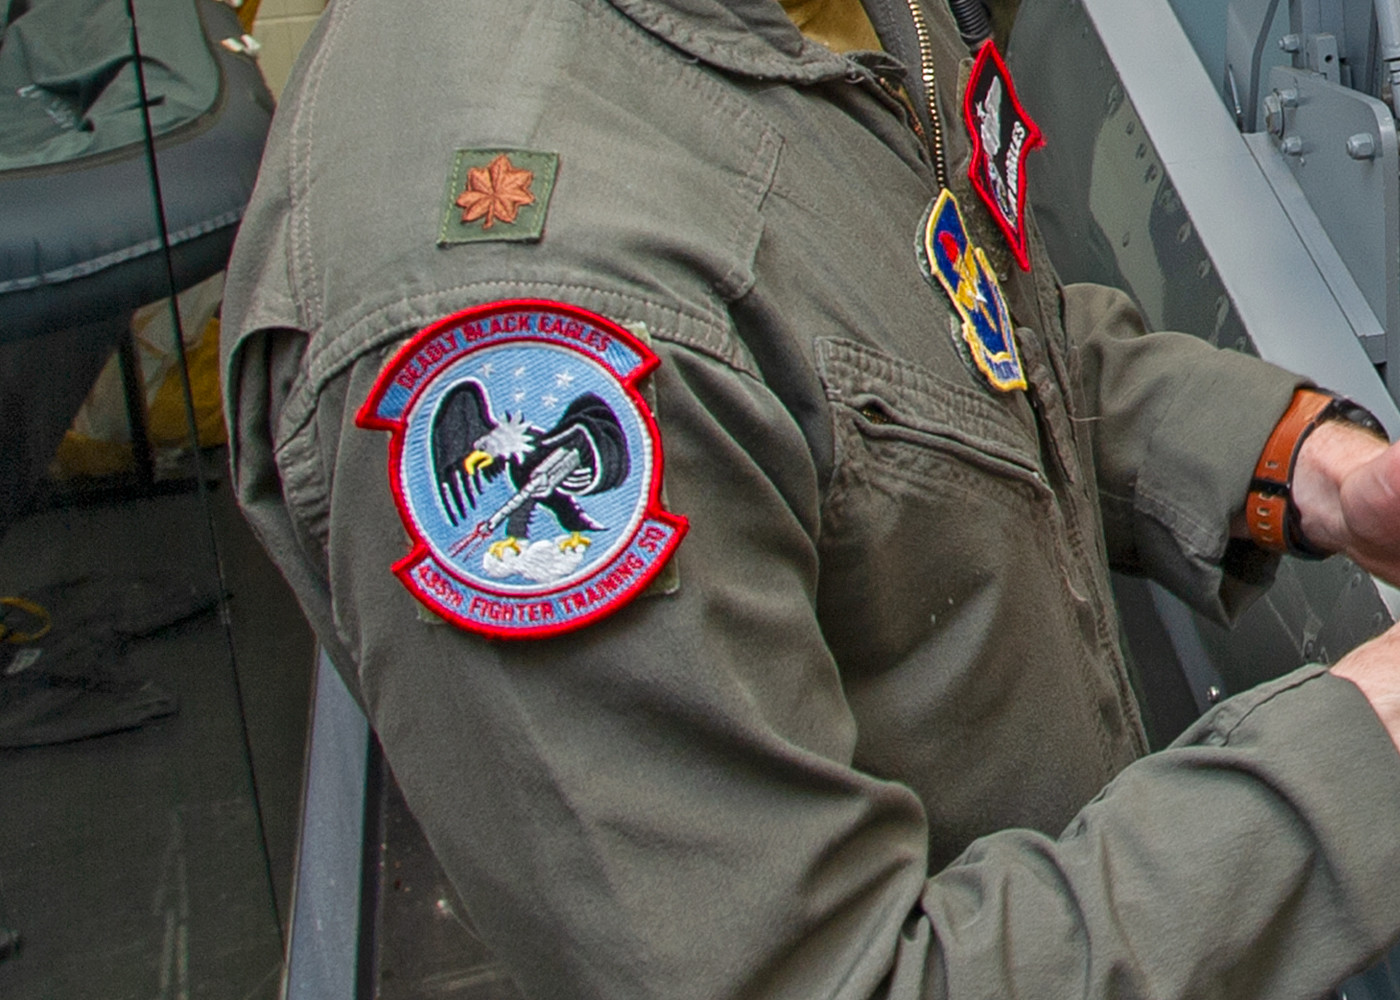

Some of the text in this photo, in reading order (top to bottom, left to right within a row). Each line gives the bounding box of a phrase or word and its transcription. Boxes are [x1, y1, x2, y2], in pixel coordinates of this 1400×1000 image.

[396, 315, 612, 389] DEADLY BLACK EAGLES
[469, 596, 555, 622] FIGHTER
[562, 554, 645, 616] TRAINING
[637, 526, 666, 551] SQ
